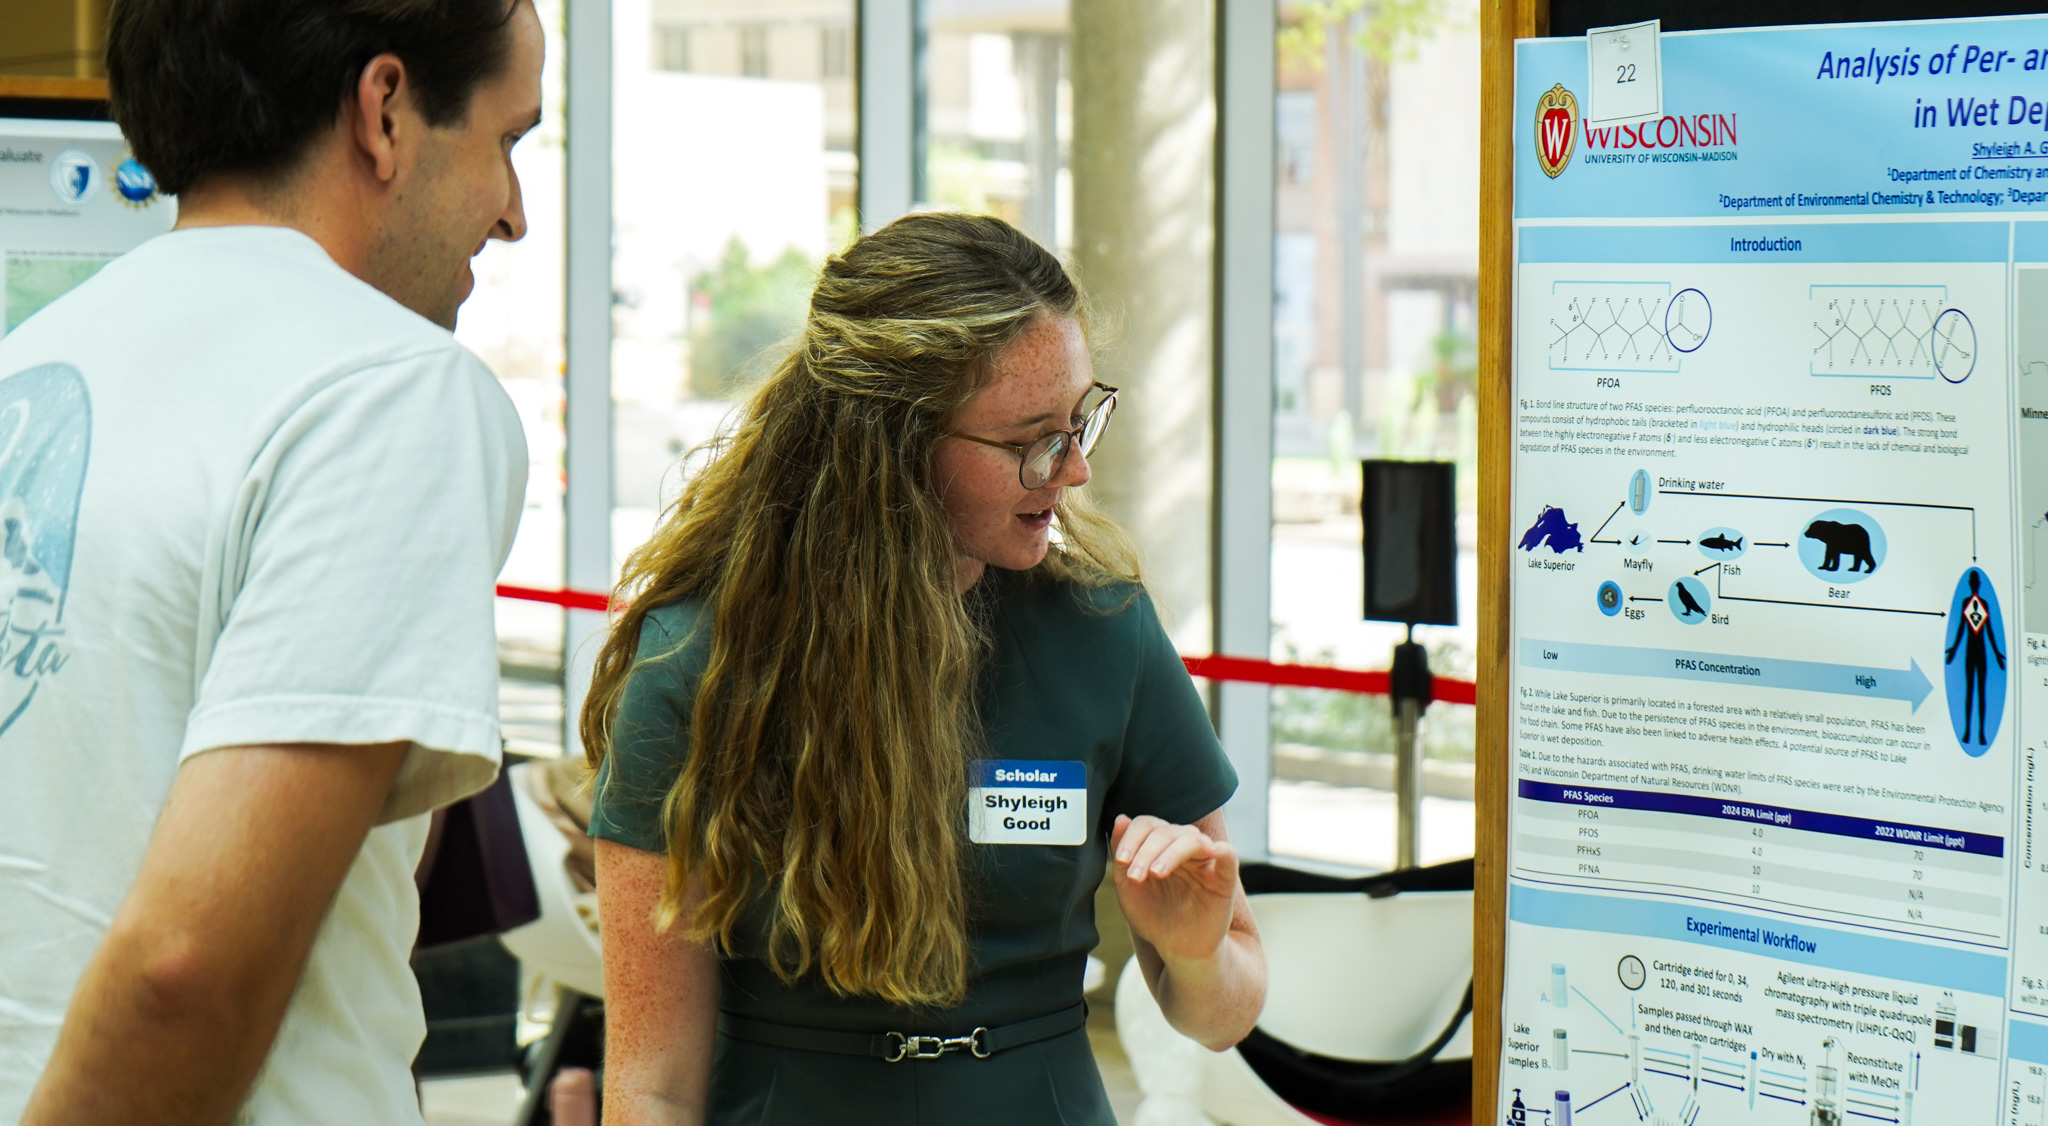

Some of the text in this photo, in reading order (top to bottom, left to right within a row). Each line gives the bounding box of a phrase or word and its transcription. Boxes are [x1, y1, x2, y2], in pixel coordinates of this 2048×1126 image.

[1817, 47, 1921, 85] Analysis
[1928, 44, 1960, 75] of
[1962, 45, 2015, 74] Per-
[1616, 64, 1636, 84] 22
[1915, 98, 1937, 128] in
[1947, 97, 1999, 128] Wet
[1544, 116, 1568, 160] W
[1972, 142, 2021, 157] Shyleigh
[2024, 141, 2036, 155] A.
[1585, 154, 1636, 164] UNIVERSITY
[1638, 154, 1650, 163] OF
[1960, 166, 1972, 180] of
[1974, 166, 2033, 182] Chemistry
[1785, 193, 1795, 207] of
[1798, 192, 1869, 207] Environmental
[1871, 191, 1923, 207] Chemistry
[1926, 191, 1934, 204] &
[1938, 190, 2004, 206] Technology;
[1731, 236, 1802, 252] Introduction
[1597, 378, 1621, 388] PFOA
[1870, 384, 1891, 396] PFOS
[1520, 399, 1529, 410] Fig.
[1530, 399, 1535, 409] 1.
[1536, 399, 1552, 409] Bond
[1553, 400, 1565, 409] line
[1566, 401, 1598, 411] structure
[1600, 401, 1608, 411] of
[1609, 403, 1624, 412] two
[1625, 402, 1643, 412] PFAS
[1645, 404, 1675, 414] species:
[1746, 407, 1762, 416] acid
[1763, 407, 1790, 418] (PFOA)
[1792, 408, 1806, 418] and
[1895, 410, 1909, 421] acid
[1936, 412, 1957, 423] These
[1659, 477, 1725, 490] Drinking water
[1528, 558, 1575, 572] Lake Superior
[1623, 558, 1654, 572] Mayfly
[1723, 564, 1741, 576] Fish
[1828, 587, 1851, 599] Bear
[1625, 607, 1646, 619] Eggs
[1712, 614, 1729, 625] Bird
[1543, 649, 1558, 660] Low
[1675, 658, 1761, 676] PFAS Concentration
[1855, 675, 1877, 689] High
[1519, 729, 1539, 742] Superior
[1547, 734, 1560, 744] wet
[1561, 734, 1604, 747] deposition.
[995, 769, 1058, 782] Scholar
[1531, 766, 1542, 775] and
[1543, 766, 1580, 779] Wisconsin
[1581, 770, 1628, 783] Department
[1630, 773, 1639, 783] of
[1640, 775, 1670, 786] Natural
[1672, 778, 1710, 791] Resources
[1563, 789, 1614, 804] PFAS Species
[985, 795, 1068, 813] Shyleigh
[1578, 809, 1599, 820] PFOA
[1722, 804, 1792, 826] 2024 EPA Limit (ppt)
[1003, 816, 1050, 830] Good
[1579, 828, 1599, 838] PFOS
[1752, 828, 1763, 838] 4.0
[1875, 825, 1966, 849] 2022 WDNR Limit (ppt)
[1577, 845, 1601, 856] PFHxS
[1752, 847, 1763, 857] 4.0
[1913, 850, 1924, 861] 70
[1578, 864, 1600, 875] PFNA
[1753, 866, 1761, 875] 10
[1913, 870, 1923, 881] 70
[1752, 884, 1760, 894] 10
[1908, 888, 1925, 901] N/A
[1907, 908, 1924, 921] N/A
[1686, 916, 1817, 954] Experimental Workflow
[1653, 960, 1749, 988] Cartridge dried for 0, 34,
[1660, 978, 1743, 1003] 120, and 301 seconds
[1777, 971, 1919, 1006] Agilent ultra-High pressure liquid
[1540, 993, 1551, 1003] A.
[1764, 986, 1932, 1028] chromatography with triple quadrupole
[1638, 1004, 1753, 1036] Samples passed through WAX
[1776, 1008, 1916, 1044] mass spectrometry (UHPLC-QqQ)
[1513, 1023, 1531, 1035] Lake
[1645, 1023, 1747, 1053] and then carbon cartridges
[1508, 1039, 1540, 1054] Superior
[1762, 1047, 1775, 1060] Dry
[1777, 1050, 1795, 1064] with
[1847, 1052, 1904, 1073] Reconstitute
[1508, 1057, 1540, 1070] samples
[1541, 1059, 1552, 1069] B.
[1848, 1072, 1900, 1090] with MeOH
